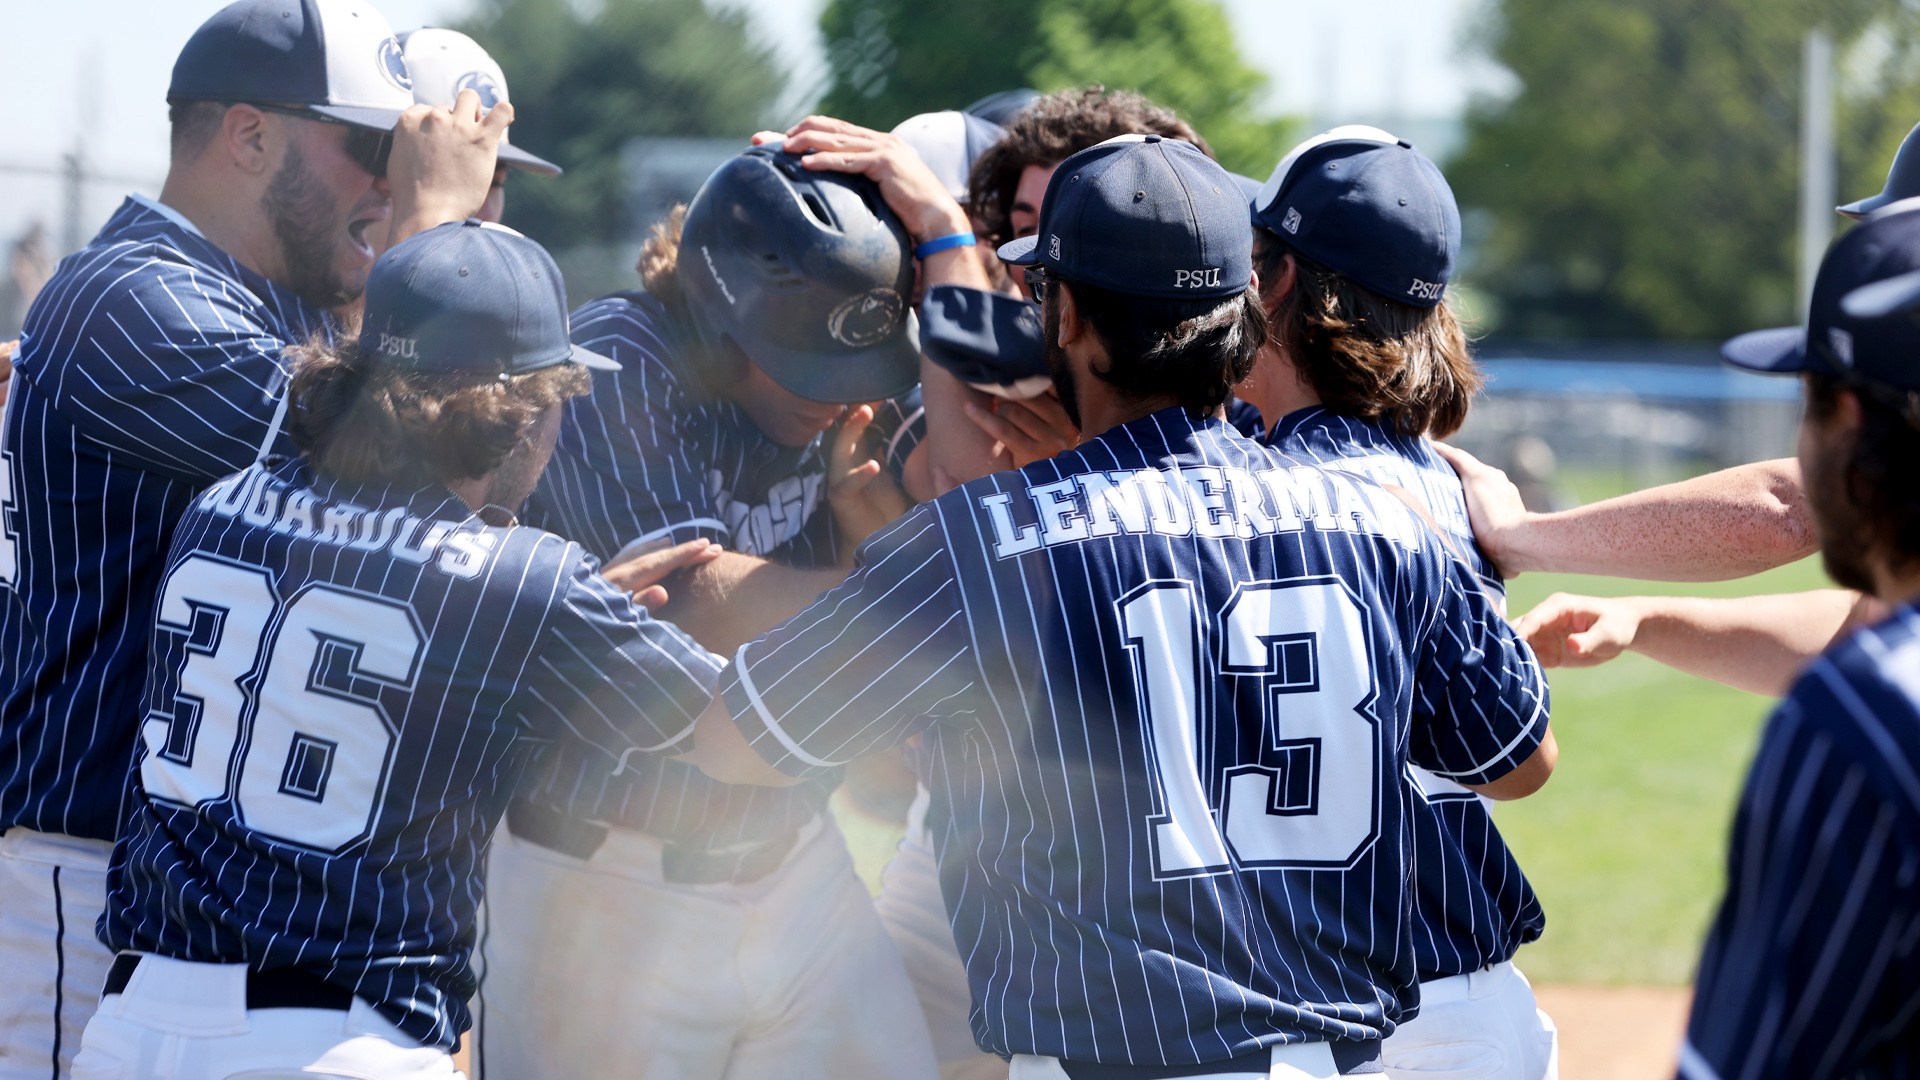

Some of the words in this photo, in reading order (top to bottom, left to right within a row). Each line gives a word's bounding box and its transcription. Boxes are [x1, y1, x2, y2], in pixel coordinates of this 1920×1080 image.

[1173, 267, 1221, 289] PSU
[1406, 278, 1443, 300] PSU
[376, 332, 418, 359] PSU
[981, 465, 1420, 562] LENDERMAN
[139, 549, 429, 861] 36
[1112, 573, 1383, 882] 13
